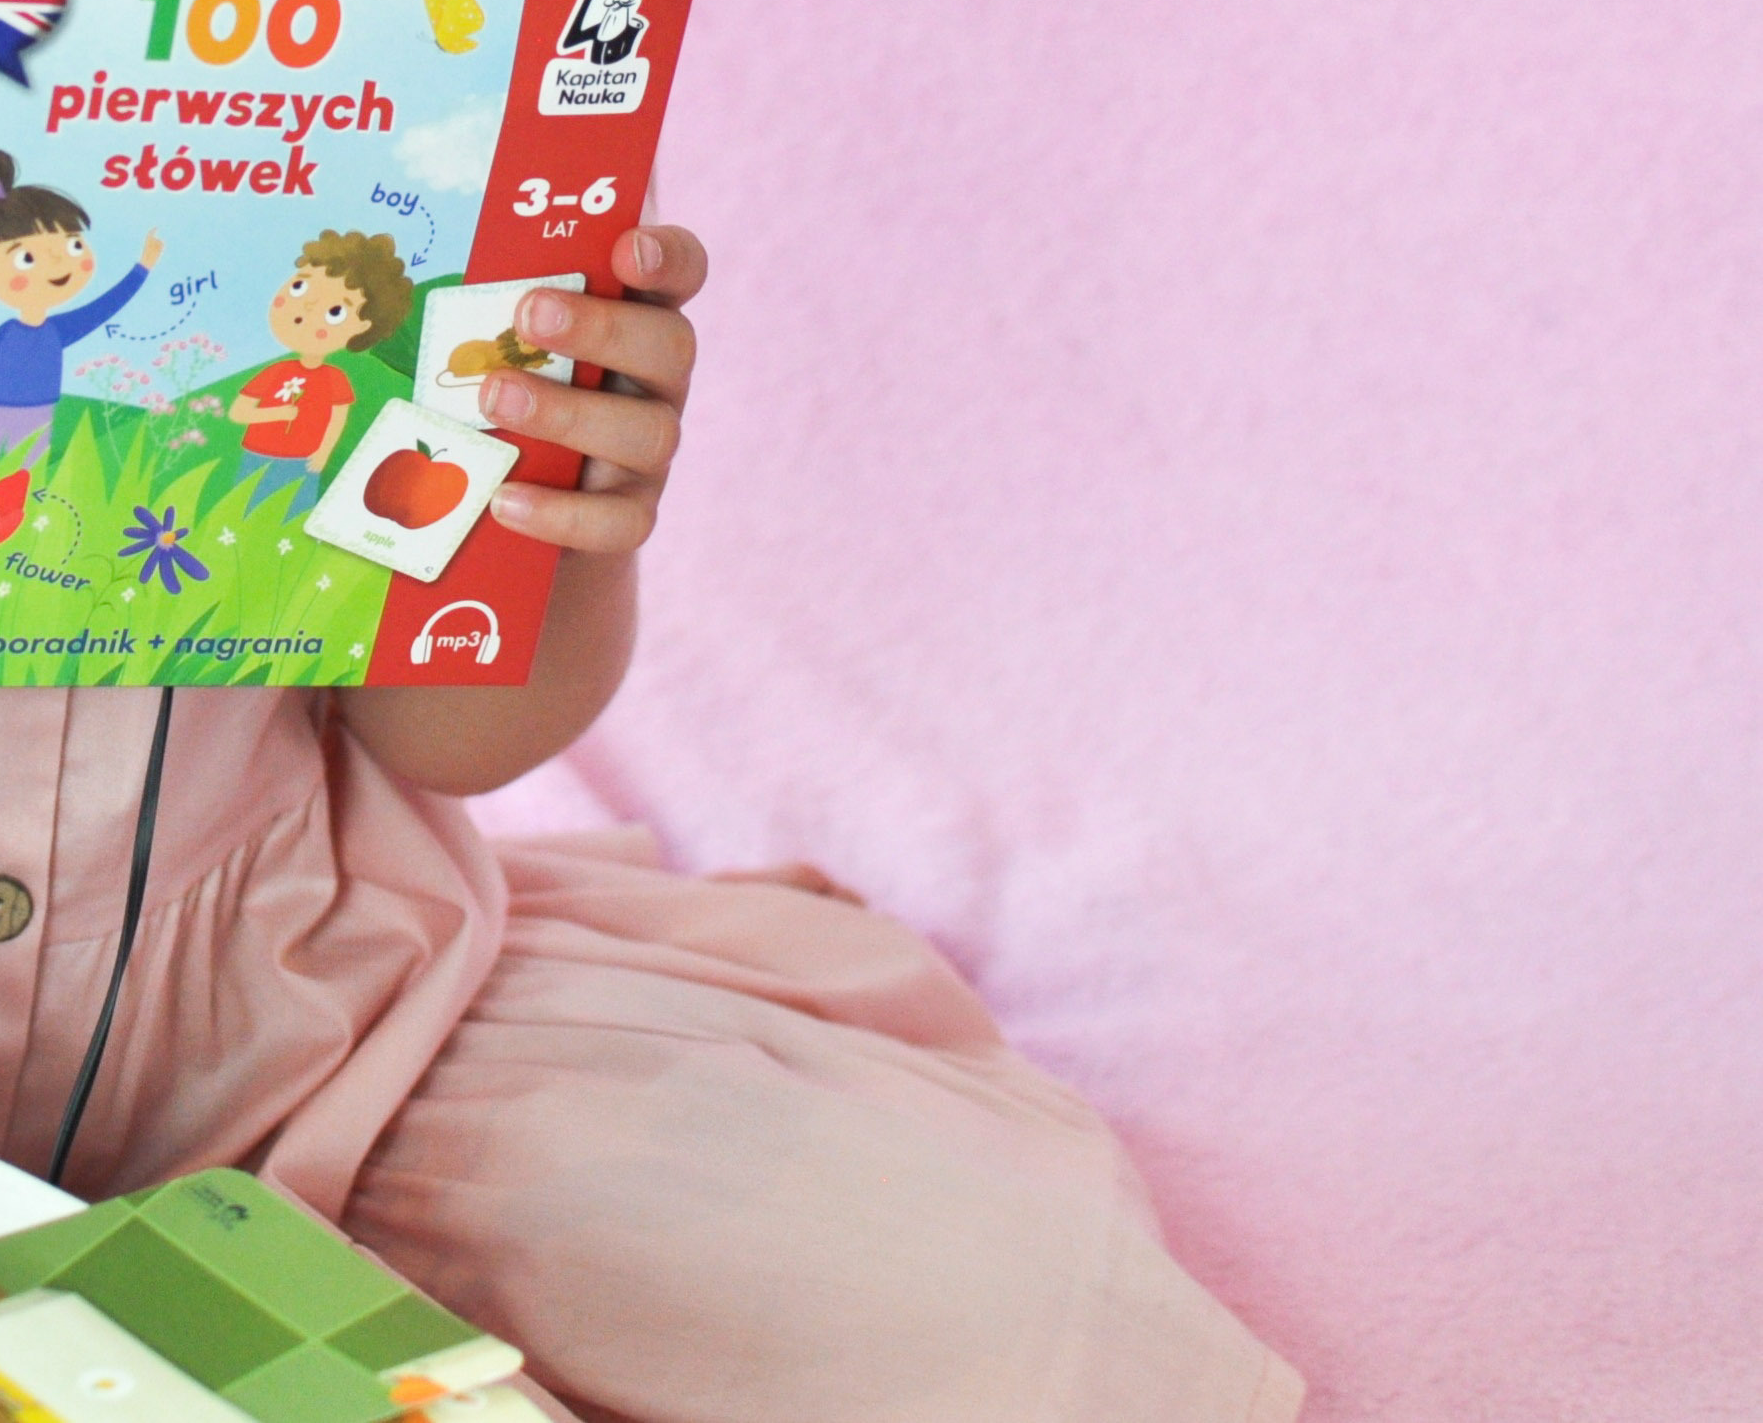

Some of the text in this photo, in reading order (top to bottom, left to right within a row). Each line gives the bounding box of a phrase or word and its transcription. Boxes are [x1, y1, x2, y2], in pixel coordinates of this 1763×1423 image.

[556, 69, 637, 89] Kapitan
[46, 70, 394, 143] pierwszych
[558, 89, 625, 105] Nauka
[100, 143, 319, 195] słówek
[370, 183, 420, 216] boy
[542, 220, 579, 238] LAT
[170, 270, 218, 305] girl
[363, 530, 396, 549] apple
[4, 552, 90, 593] flower
[173, 630, 324, 663] nagrania
[436, 630, 481, 656] mp3
